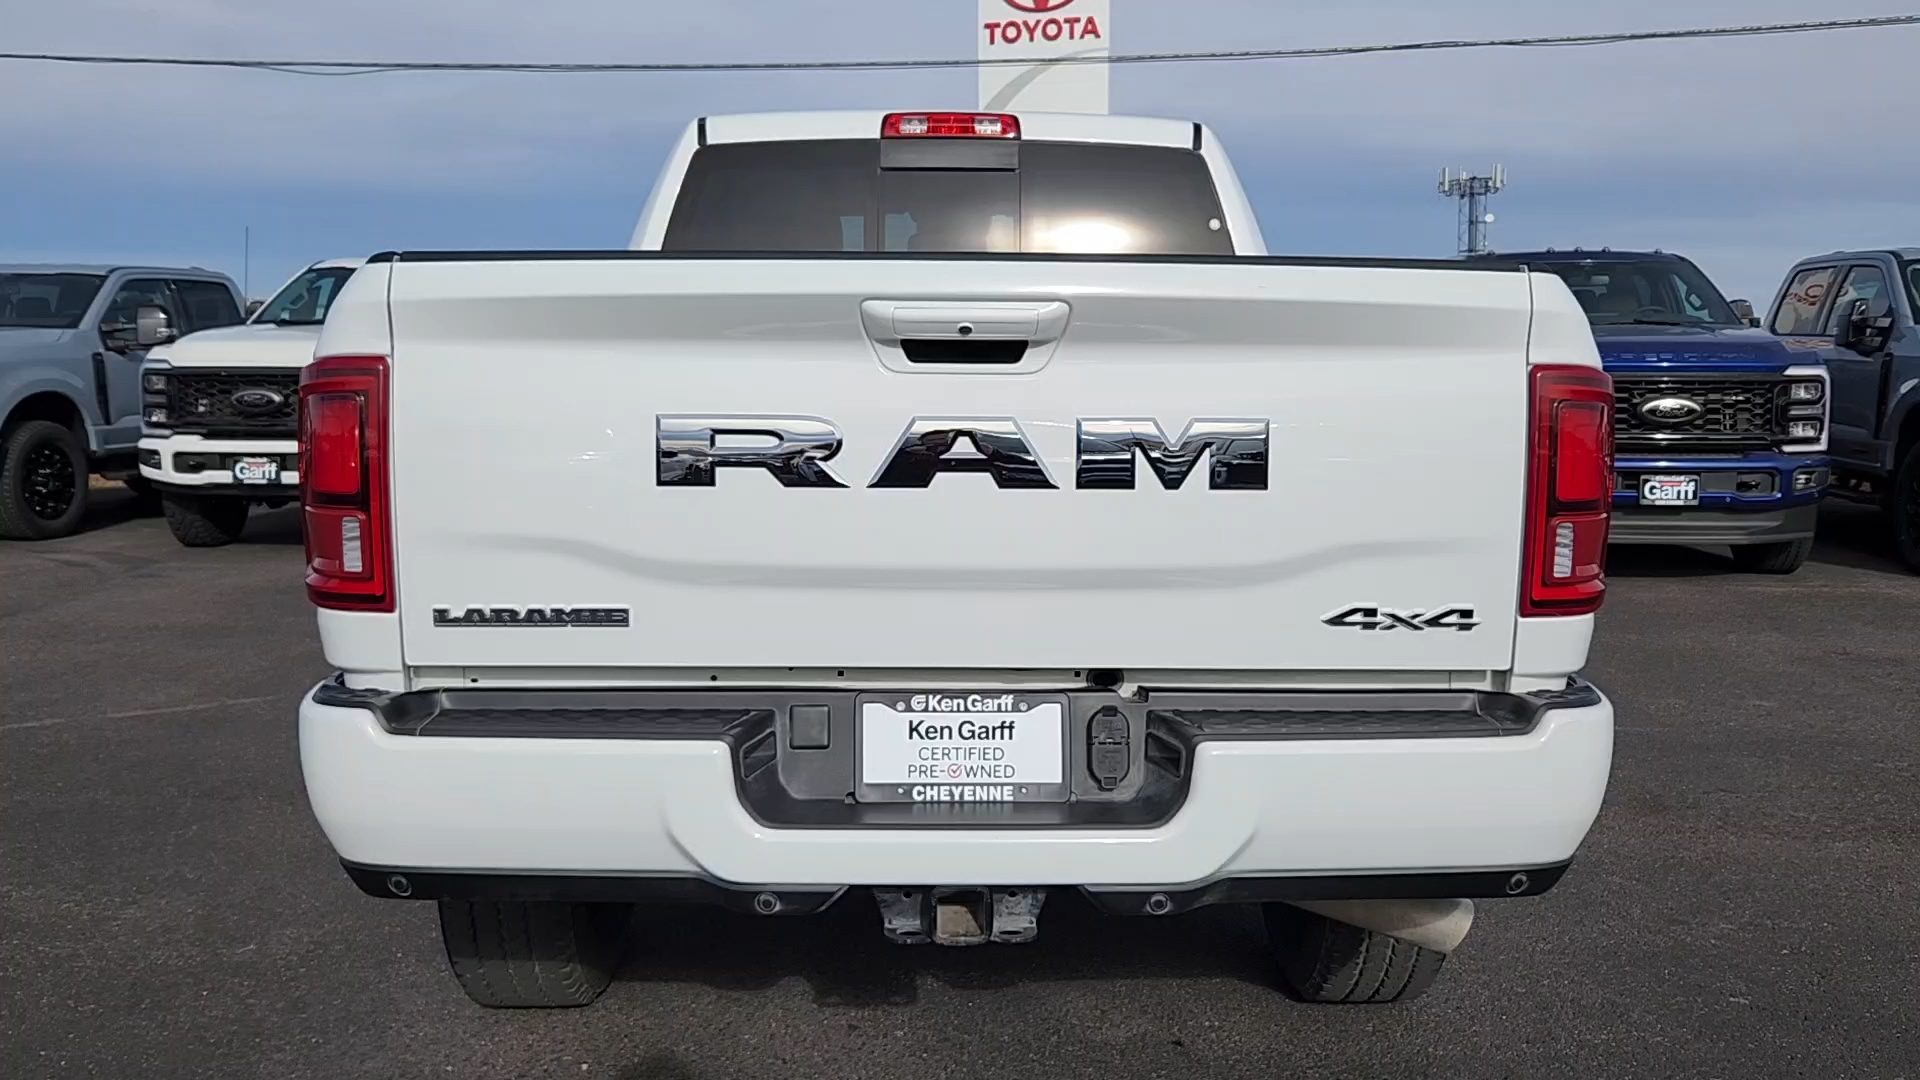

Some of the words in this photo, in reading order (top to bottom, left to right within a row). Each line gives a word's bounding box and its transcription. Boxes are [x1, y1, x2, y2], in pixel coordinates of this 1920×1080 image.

[984, 16, 1101, 45] TOYOTA
[656, 413, 1271, 491] RAM
[235, 461, 278, 479] Garff
[1643, 481, 1696, 500] Garff
[433, 602, 630, 628] LARAMIE
[928, 695, 965, 712] Ken
[966, 694, 1014, 712] Garff
[908, 720, 953, 741] Ken
[958, 721, 1015, 741] Garff
[918, 747, 1005, 761] CERTIFIED
[912, 785, 1014, 801] CHEYENNE
